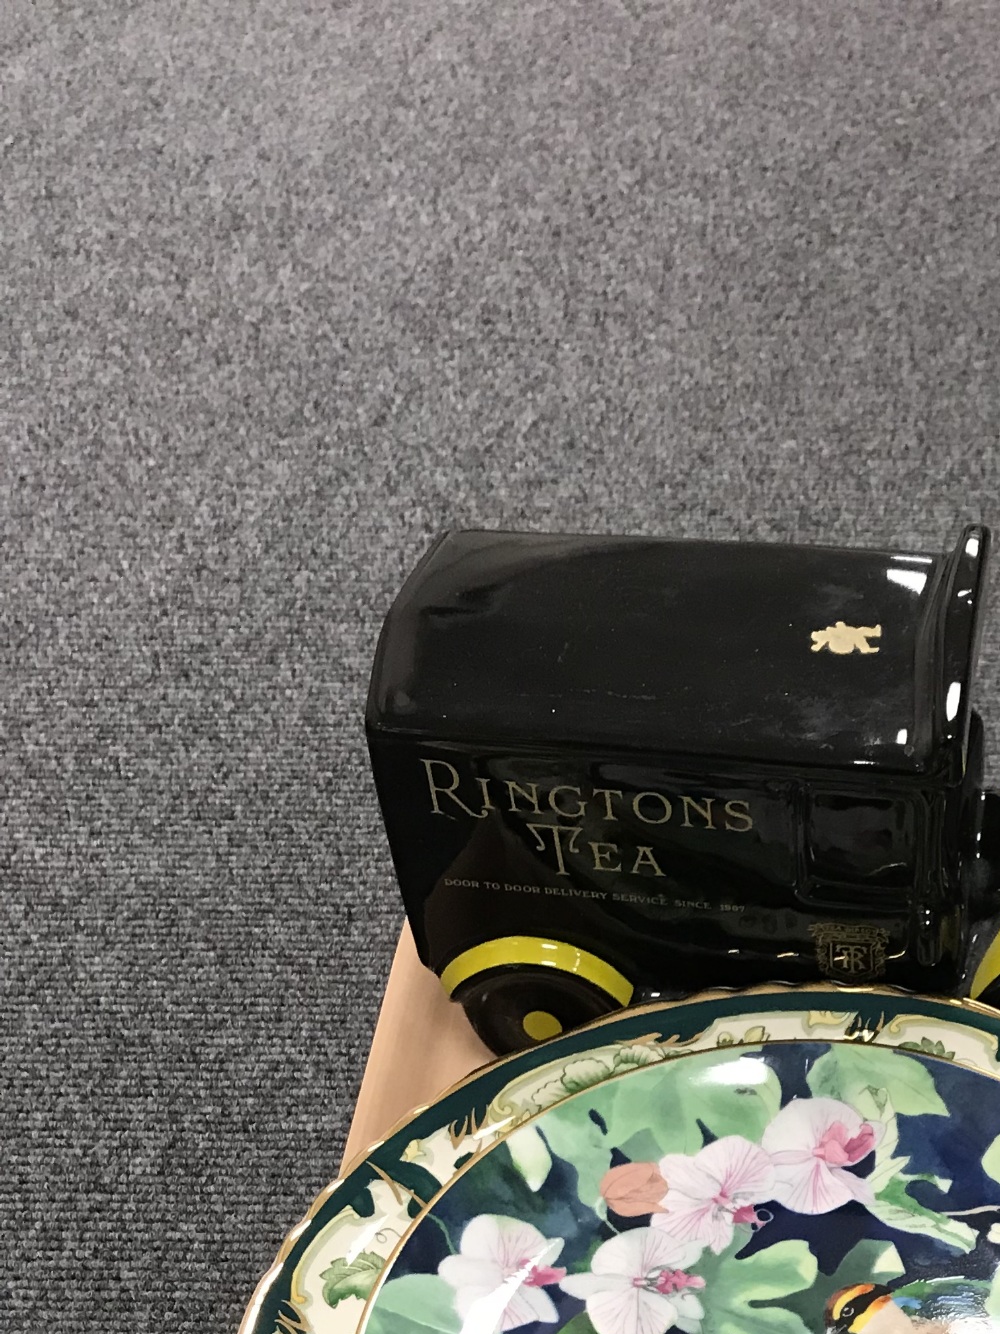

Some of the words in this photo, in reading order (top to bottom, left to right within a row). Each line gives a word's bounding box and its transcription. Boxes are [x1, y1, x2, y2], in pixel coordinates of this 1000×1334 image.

[419, 758, 754, 832] RINGTONS
[526, 823, 667, 877] TEA
[444, 878, 481, 889] DOOR
[483, 880, 501, 891] TO
[504, 883, 541, 895] DOOR
[544, 886, 608, 899] DELIVERY
[611, 893, 668, 907] SERVICE
[673, 898, 712, 910] SINCE
[719, 903, 746, 913] 1907
